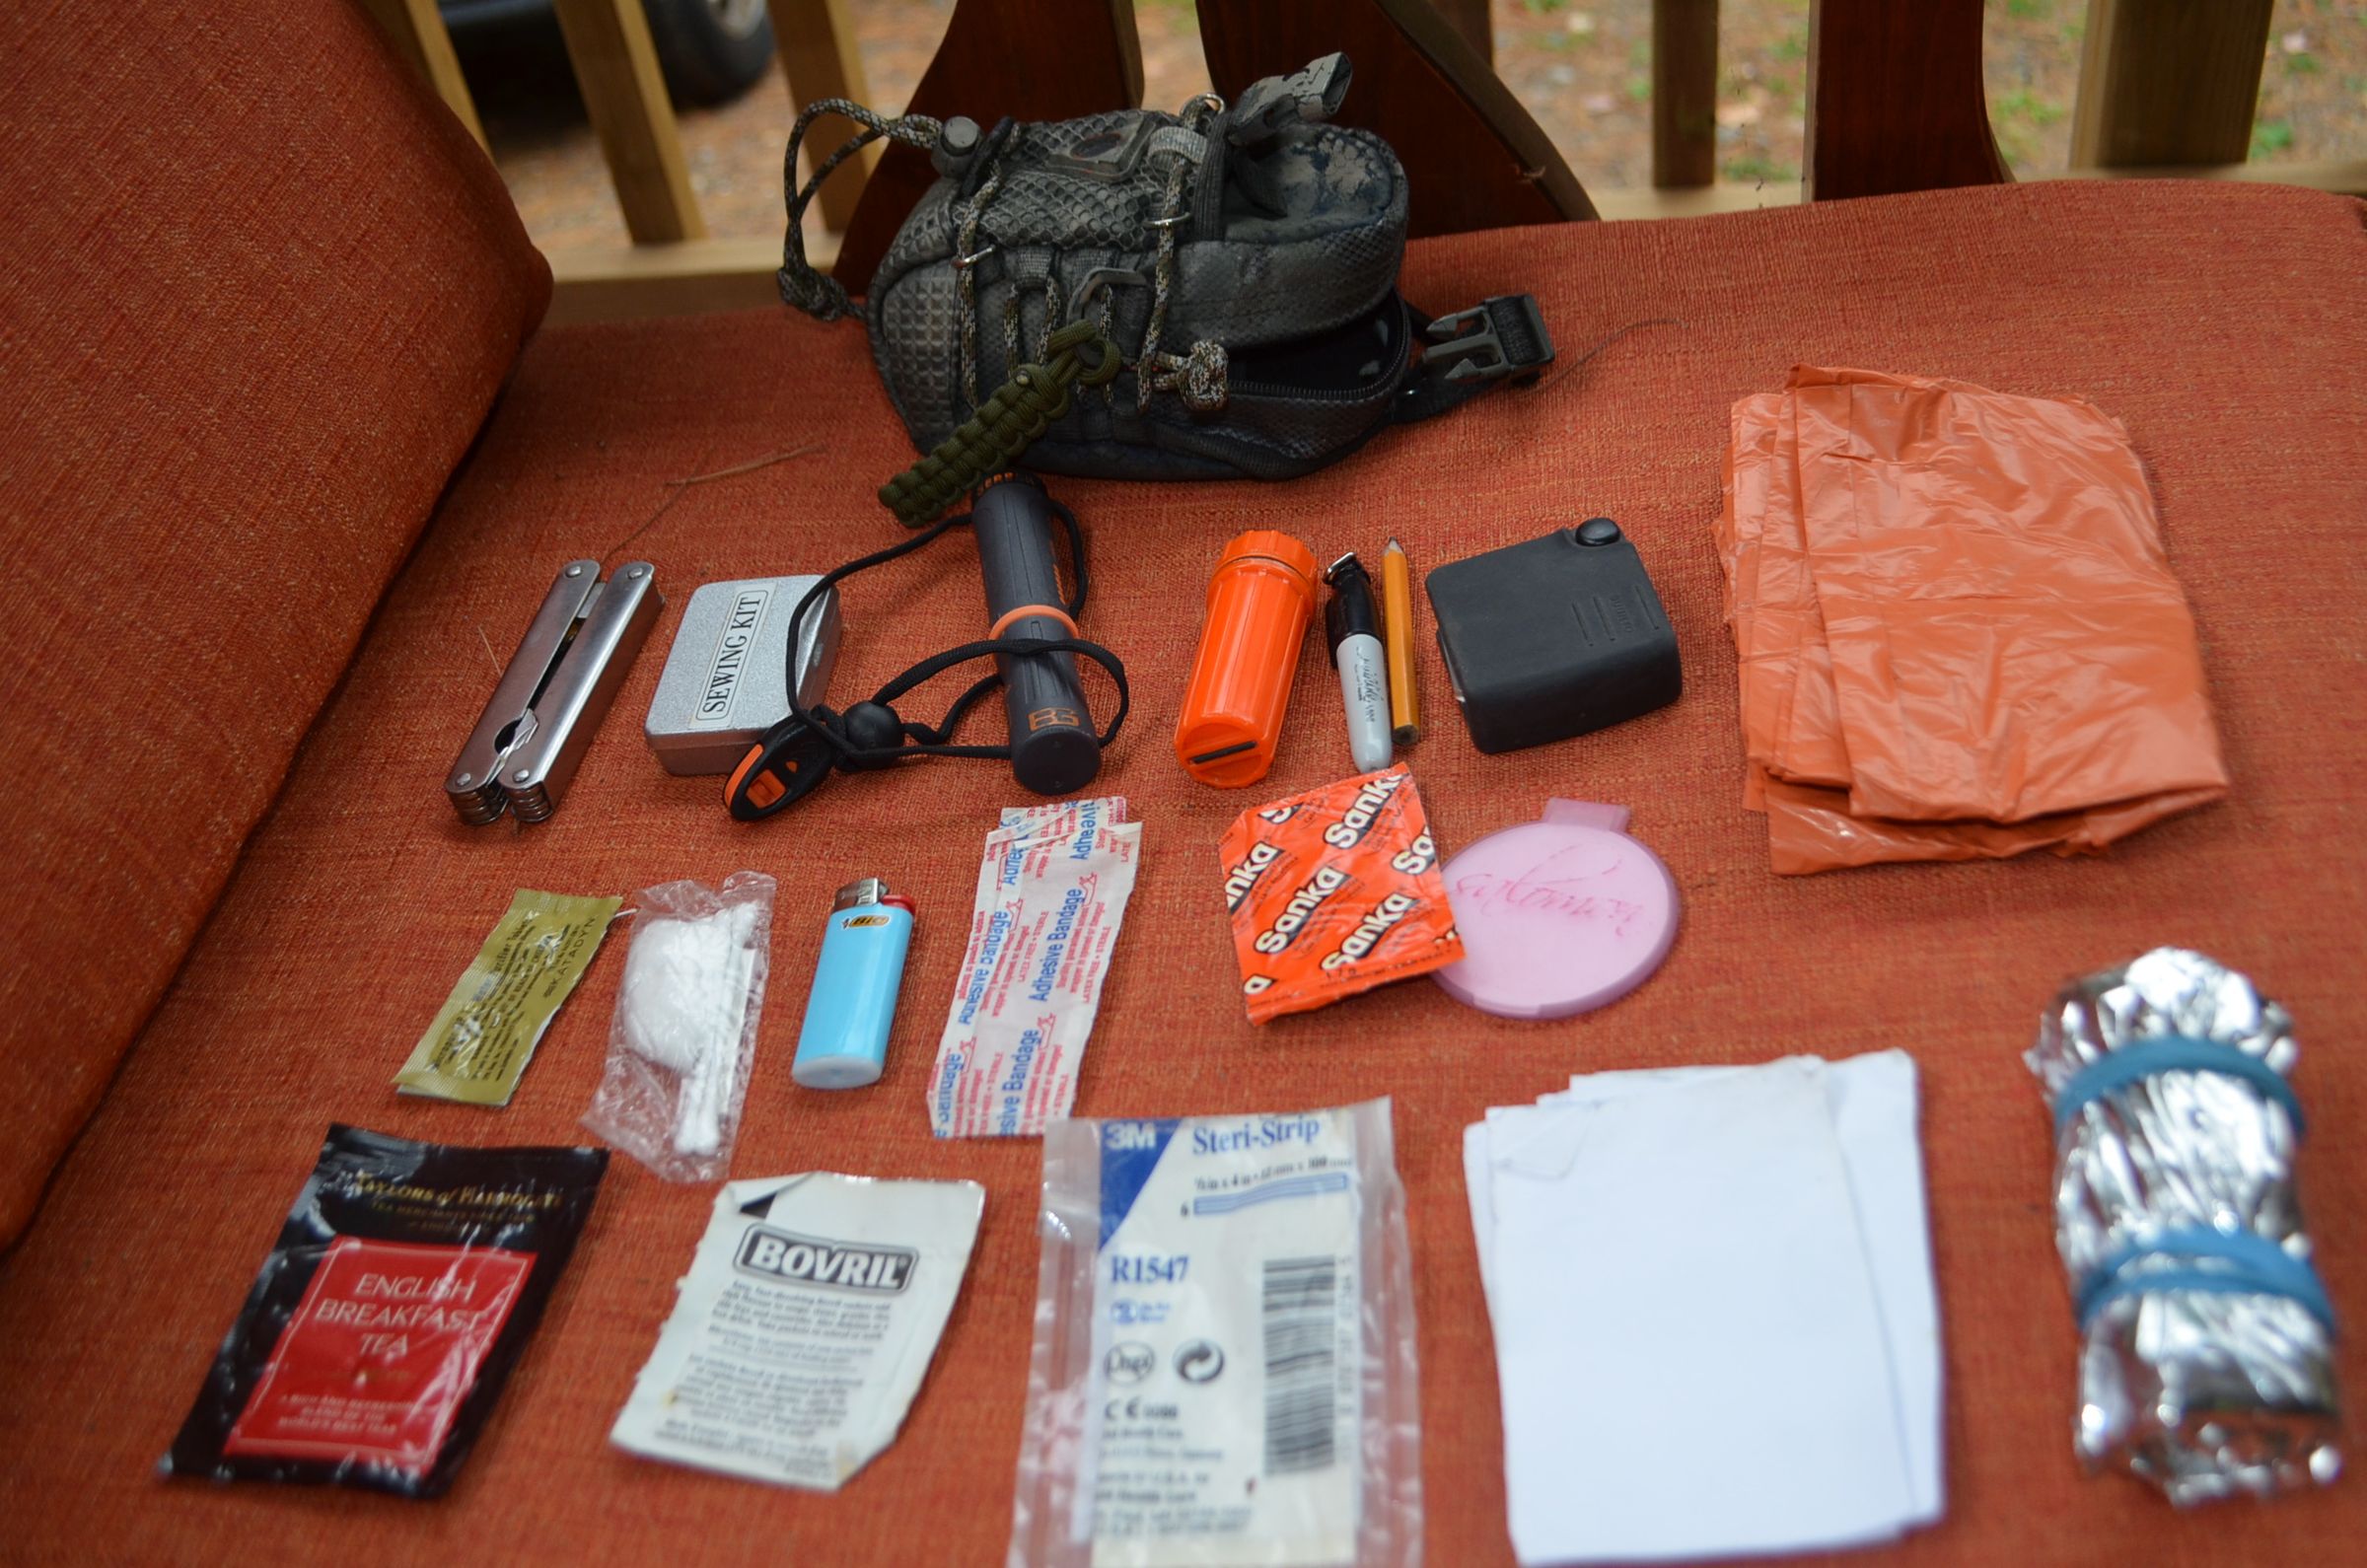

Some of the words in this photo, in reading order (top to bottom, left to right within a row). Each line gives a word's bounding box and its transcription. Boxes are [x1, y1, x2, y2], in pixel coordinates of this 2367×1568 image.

[703, 635, 748, 713] SEWING
[731, 596, 759, 631] KIT
[1255, 866, 1347, 954] Sanka
[1321, 892, 1415, 971] Sanka
[550, 917, 595, 986] KATADYN
[1030, 945, 1062, 1000] Adhesive
[1047, 890, 1083, 940] Bandage
[1002, 1031, 1040, 1090] Bandage
[1106, 1122, 1156, 1150] 3M
[1192, 1115, 1320, 1155] Steri-Strip
[354, 1272, 477, 1304] ENGLISH
[749, 1235, 901, 1290] BOVRIL
[1112, 1255, 1189, 1284] R1547
[315, 1298, 485, 1331] BREAKFAST
[359, 1333, 408, 1357] TEA
